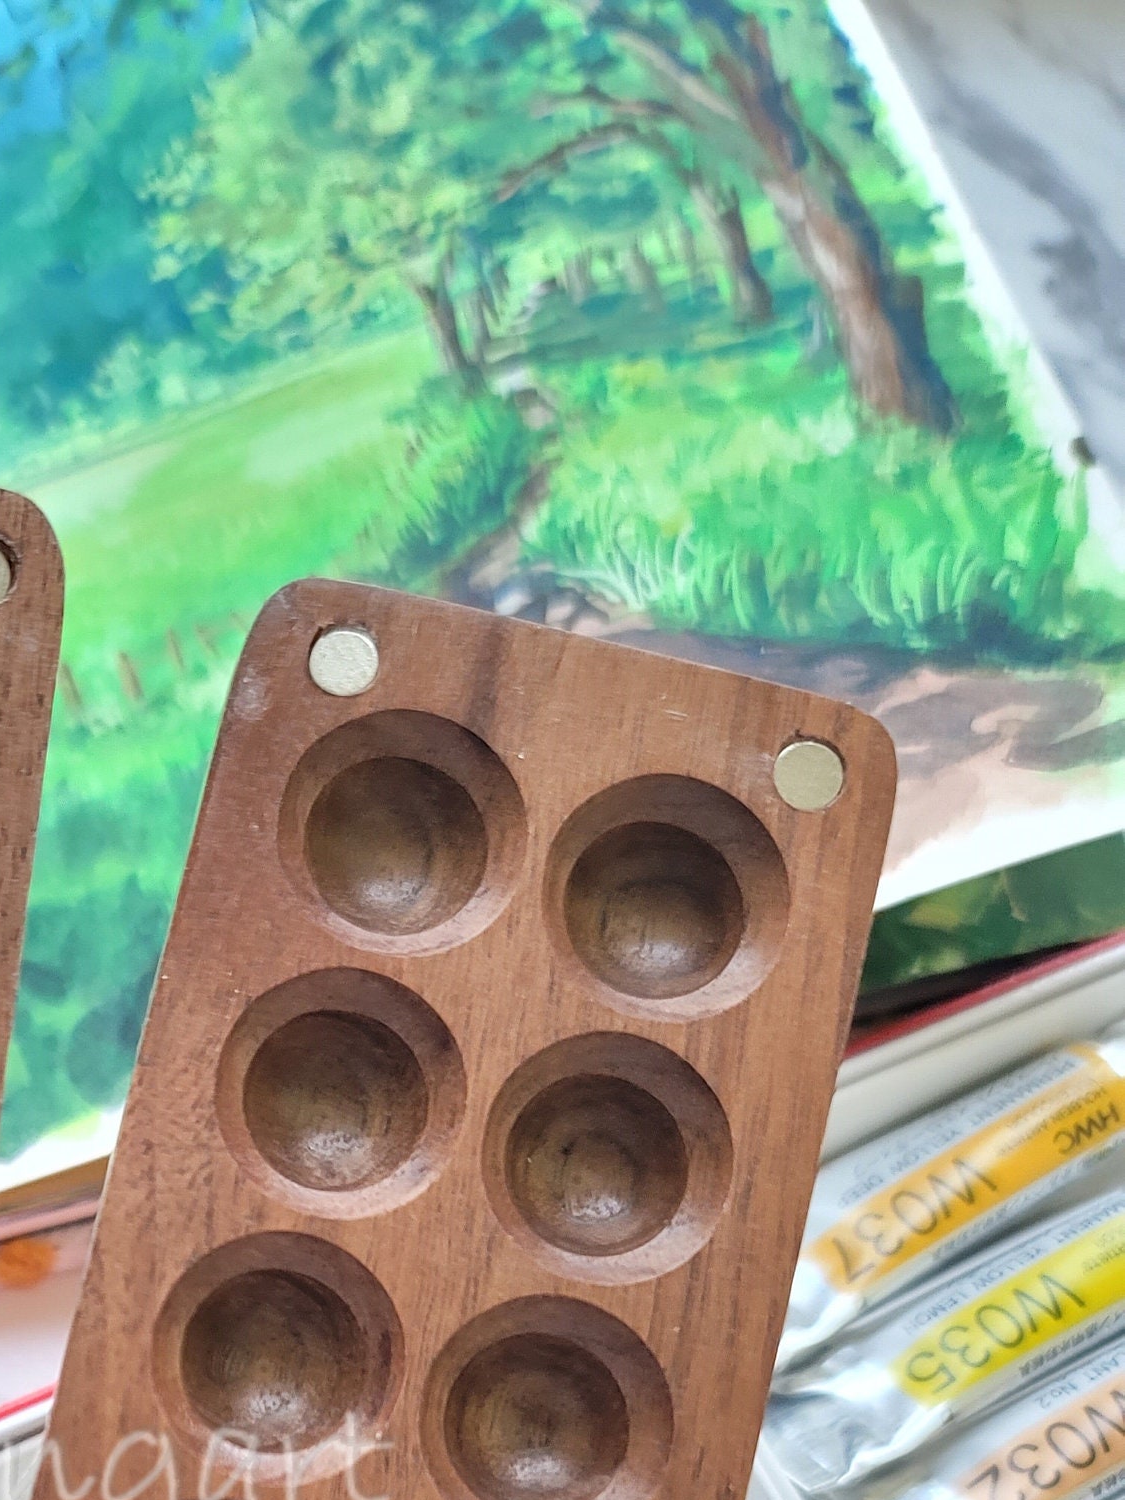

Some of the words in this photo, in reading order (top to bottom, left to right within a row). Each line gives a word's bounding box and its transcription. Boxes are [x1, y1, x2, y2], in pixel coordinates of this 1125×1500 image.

[1051, 1102, 1121, 1155] HWC
[832, 1155, 997, 1283] W037
[904, 1271, 1086, 1395] W035
